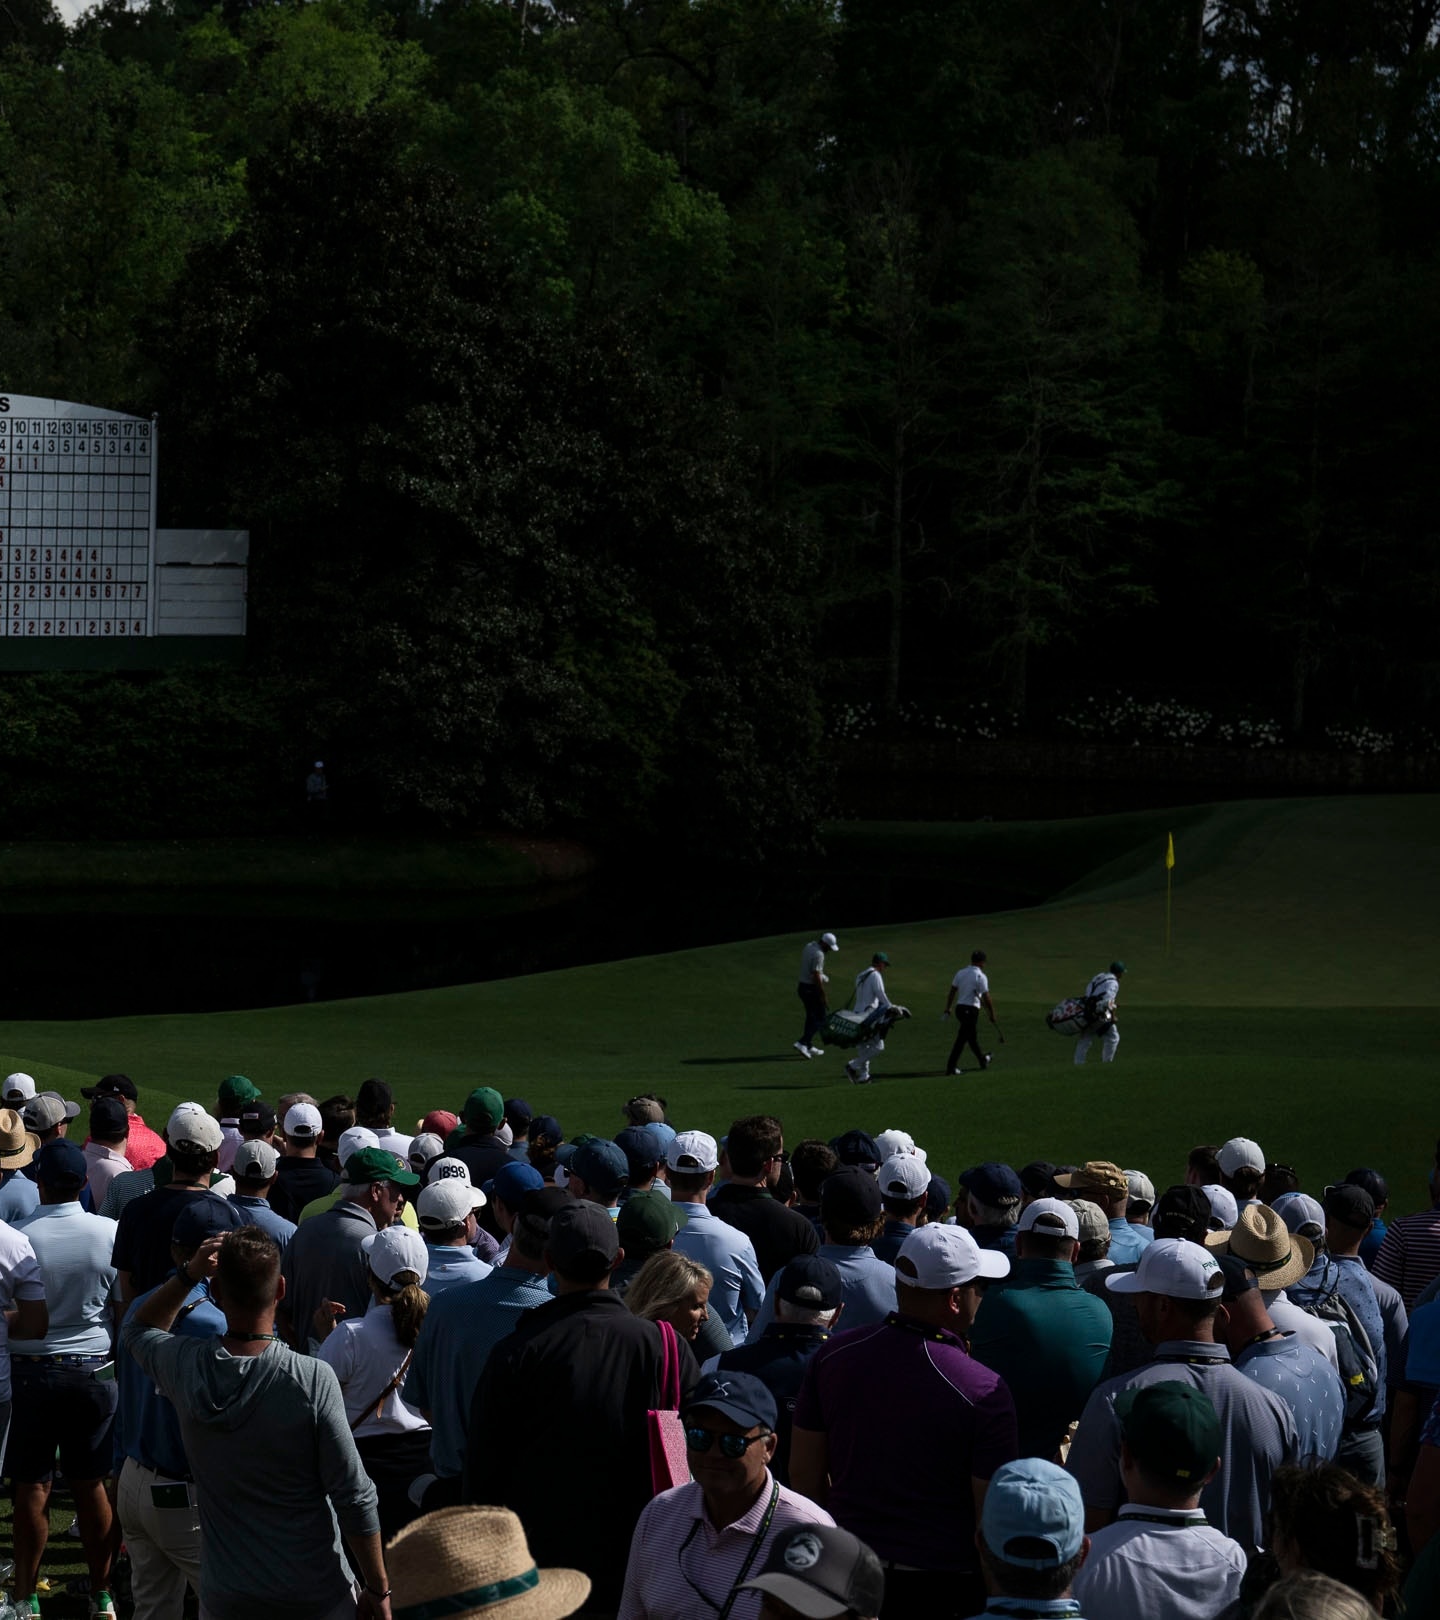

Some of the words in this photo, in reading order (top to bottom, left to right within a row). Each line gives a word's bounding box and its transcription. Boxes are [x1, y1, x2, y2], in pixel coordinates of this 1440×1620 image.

[0, 420, 7, 433] 9
[15, 421, 26, 434] 10
[32, 422, 41, 434] 11
[47, 422, 57, 434] 12
[62, 422, 72, 435] 13
[77, 423, 88, 434] 14
[92, 423, 103, 435] 15
[108, 423, 118, 436] 16
[123, 423, 132, 436] 17
[138, 424, 149, 436] 18
[0, 439, 6, 452] 4
[16, 439, 23, 452] 4
[32, 440, 39, 452] 4
[48, 439, 55, 452] 3
[63, 440, 70, 453] 5
[78, 441, 85, 453] 4
[94, 440, 100, 453] 5
[109, 440, 116, 454] 3
[124, 441, 130, 454] 4
[139, 442, 146, 454] 4
[15, 548, 21, 561] 3
[30, 549, 37, 562] 2
[46, 549, 52, 562] 3
[60, 549, 66, 562] 4
[76, 549, 82, 562] 4
[91, 550, 97, 562] 4
[15, 567, 21, 579] 5
[30, 567, 36, 580] 5
[45, 567, 52, 580] 5
[60, 567, 66, 580] 4
[75, 567, 81, 580] 4
[90, 567, 96, 580] 4
[106, 568, 112, 580] 3
[14, 585, 20, 598] 2
[29, 585, 35, 598] 2
[44, 585, 51, 598] 3
[60, 586, 66, 598] 4
[75, 586, 81, 598] 4
[90, 586, 97, 598] 5
[105, 585, 111, 598] 6
[120, 585, 127, 598] 7
[135, 586, 141, 598] 7
[13, 603, 20, 616] 2
[13, 621, 20, 634] 2
[28, 621, 35, 634] 2
[44, 621, 51, 634] 2
[59, 621, 65, 634] 2
[89, 621, 96, 634] 2
[104, 621, 110, 634] 3
[119, 621, 126, 634] 3
[134, 621, 140, 634] 4
[439, 1165, 466, 1180] 1898
